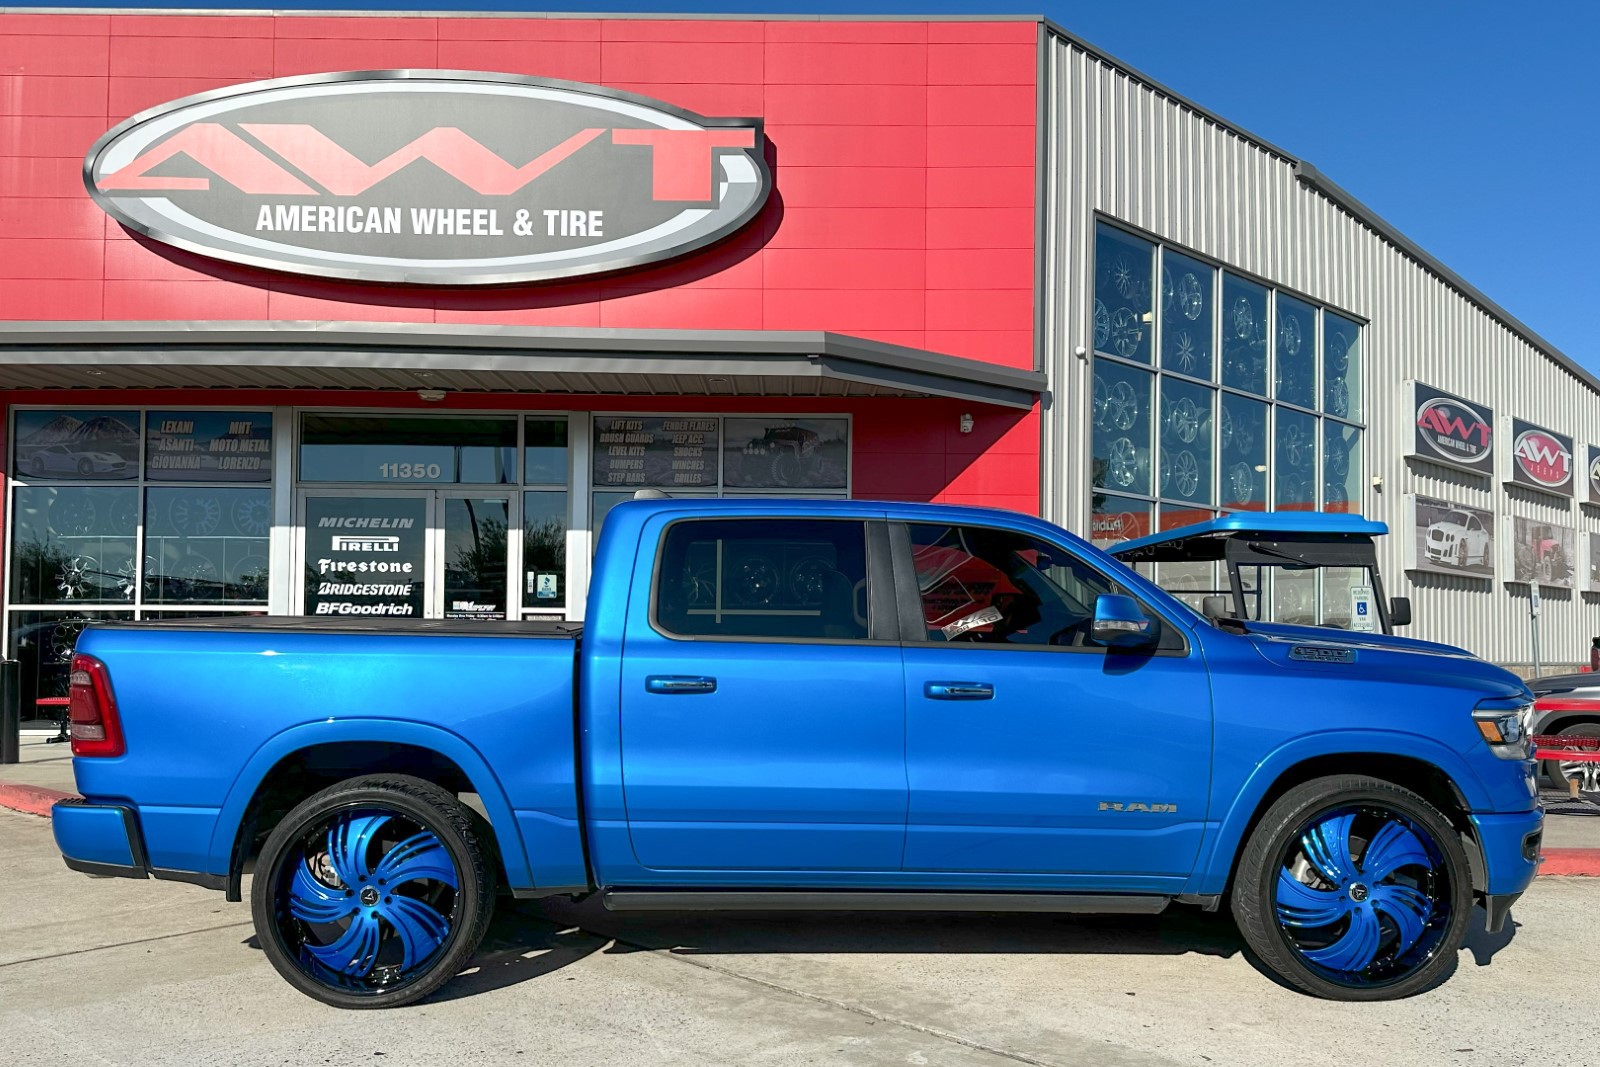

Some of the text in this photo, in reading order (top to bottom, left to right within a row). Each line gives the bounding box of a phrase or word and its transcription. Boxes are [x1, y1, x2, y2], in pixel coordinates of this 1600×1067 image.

[96, 123, 755, 201] AWT
[256, 205, 603, 237] AMERICAN WHEEL & TIRE
[161, 421, 194, 434] LEXANI
[229, 421, 253, 434] MHT
[611, 420, 643, 430] LIFT KITS
[1417, 407, 1492, 448] AWT
[159, 438, 195, 451] ASANTI
[209, 438, 270, 452] MOTO METAL
[608, 446, 645, 456] LEVEL KITS
[152, 455, 201, 469] GIOVANNA
[1514, 438, 1572, 473] AWT
[218, 456, 260, 470] LORENZO
[609, 459, 644, 469] BUMPERS
[379, 463, 441, 479] 11350
[607, 472, 625, 482] STEP
[673, 473, 702, 483] GRILLES
[318, 517, 415, 529] MICHELIN
[331, 535, 400, 552] PIRELLI
[317, 558, 413, 575] Firestone
[317, 582, 413, 596] BRIDGESTONE
[315, 602, 413, 615] BFGoodrich
[1098, 801, 1177, 813] RAM
